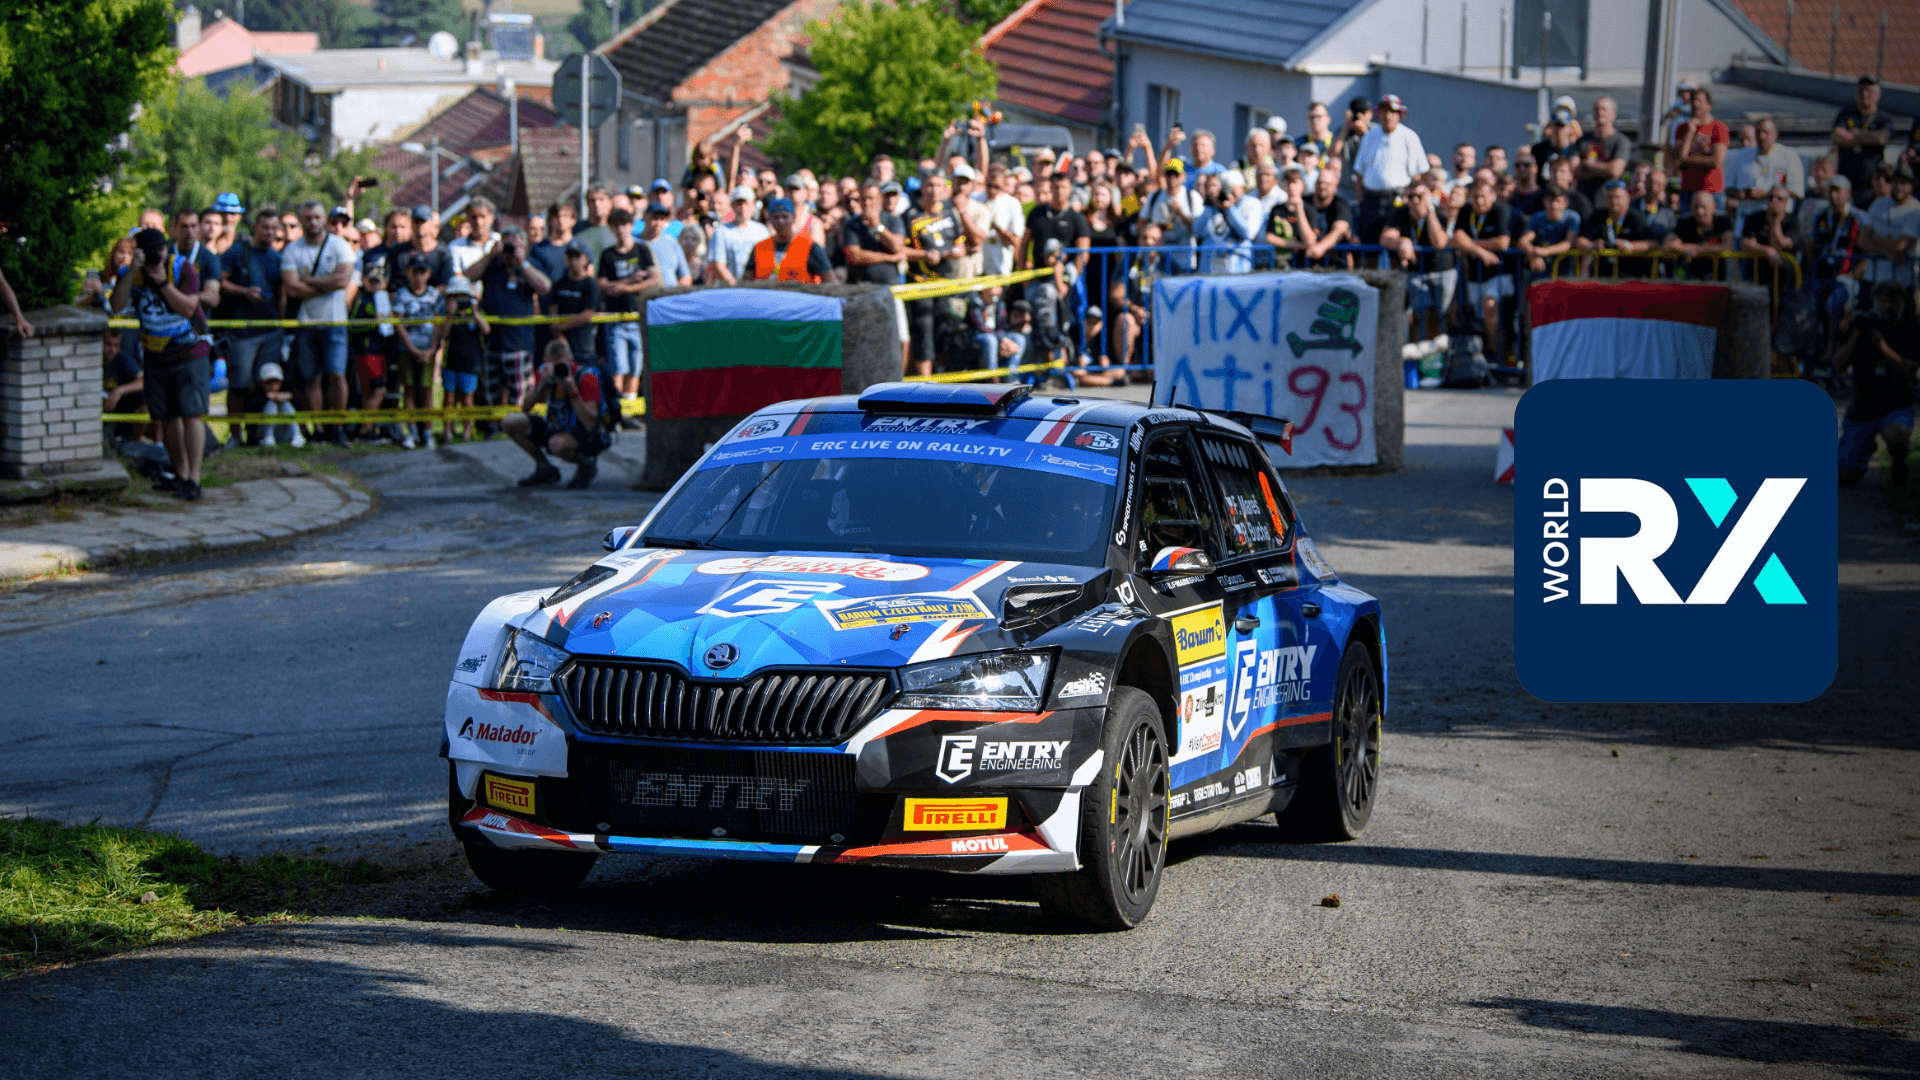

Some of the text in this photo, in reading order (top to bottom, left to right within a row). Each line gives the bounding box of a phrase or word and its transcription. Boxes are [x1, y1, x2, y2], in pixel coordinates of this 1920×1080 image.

[864, 425, 967, 435] ENGINEERING
[871, 417, 991, 430] ENTRY
[811, 440, 1012, 457] ERC LIVE ON RALLY.TV
[838, 609, 880, 620] BARUM
[919, 604, 950, 614] RALLY
[1178, 626, 1215, 651] Barum
[1256, 645, 1318, 687] ENTRY
[1253, 680, 1311, 710] ENGINEERING
[476, 722, 538, 746] Matador
[982, 741, 1071, 759] ENTRY
[979, 759, 1062, 770] ENGINEERING
[490, 781, 530, 807] PIRELLI
[632, 773, 811, 811] ENTRY
[913, 803, 999, 824] PIRELLI
[951, 837, 1008, 853] MOTUL
